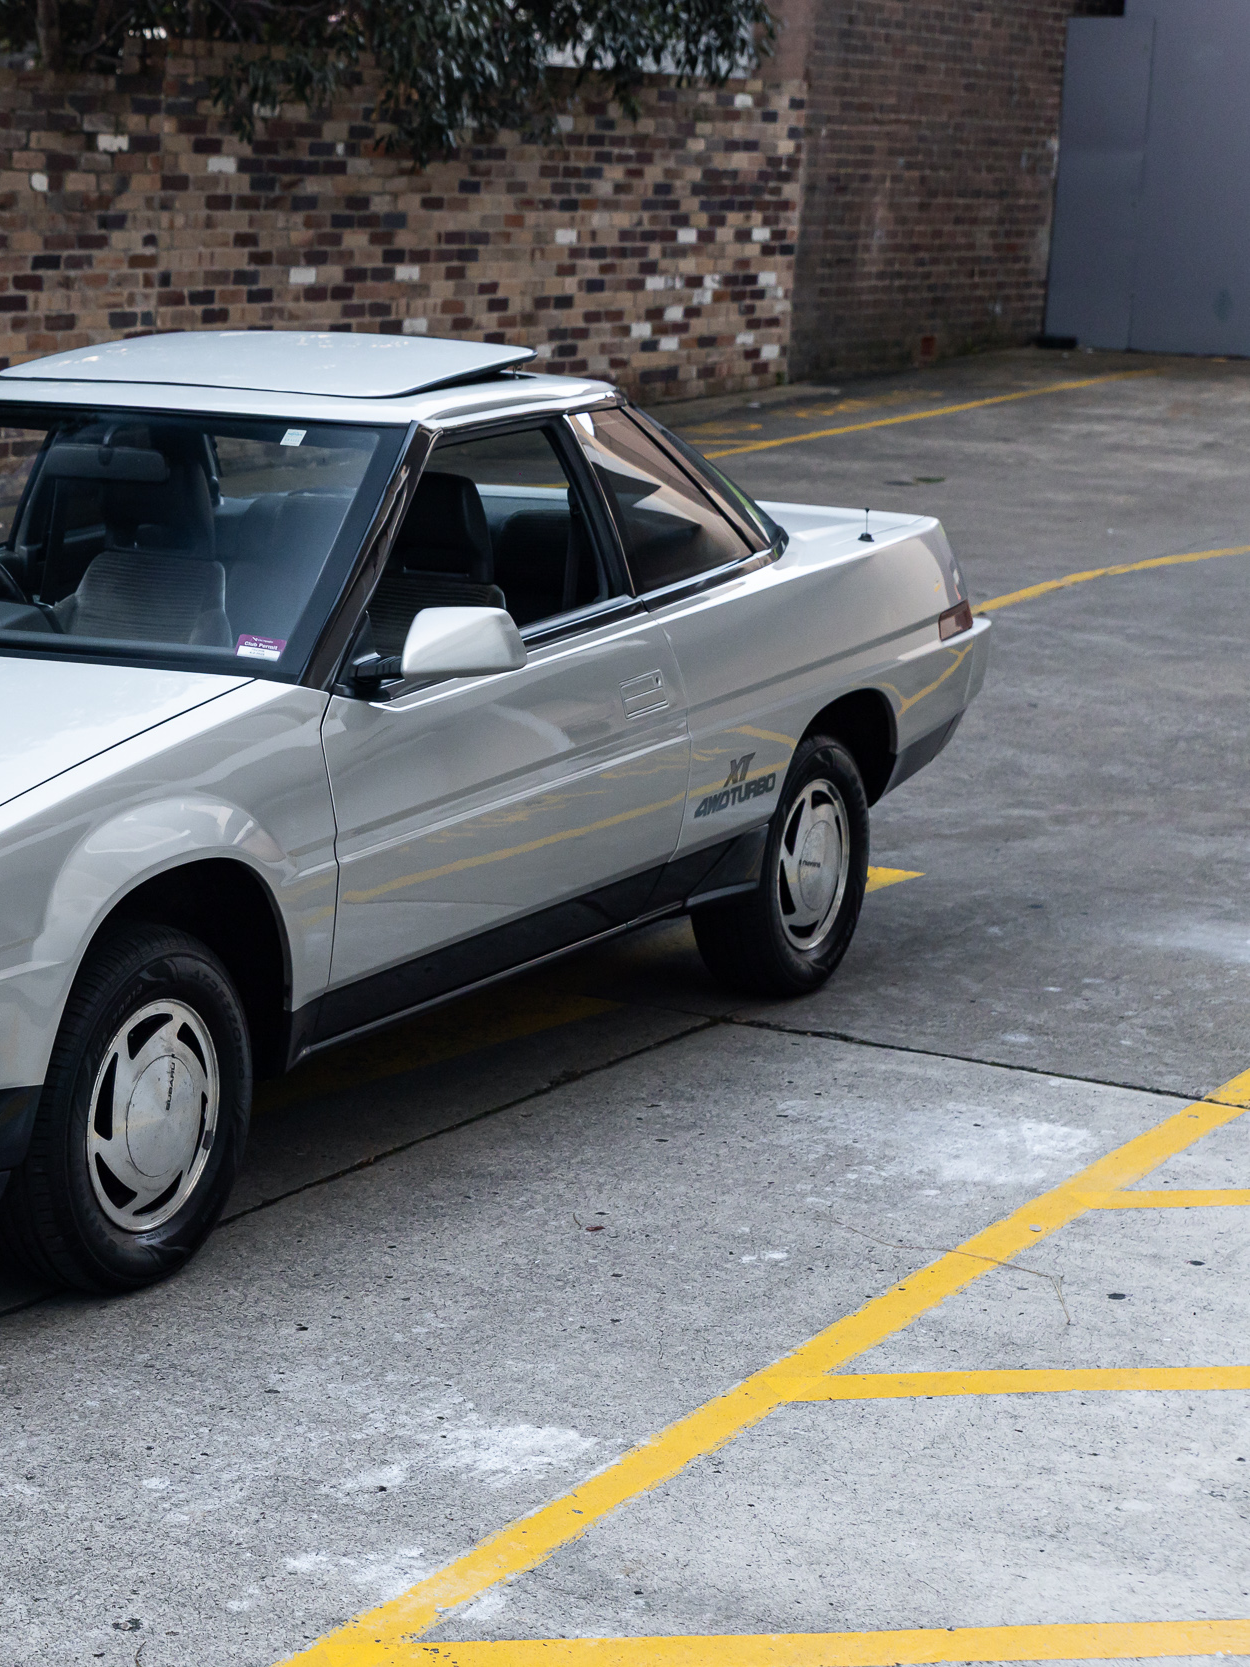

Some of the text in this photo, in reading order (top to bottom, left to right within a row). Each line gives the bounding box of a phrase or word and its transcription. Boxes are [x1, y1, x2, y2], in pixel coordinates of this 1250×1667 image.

[258, 643, 278, 651] Permit
[723, 751, 757, 788] XT
[165, 1061, 176, 1111] SUBARU
